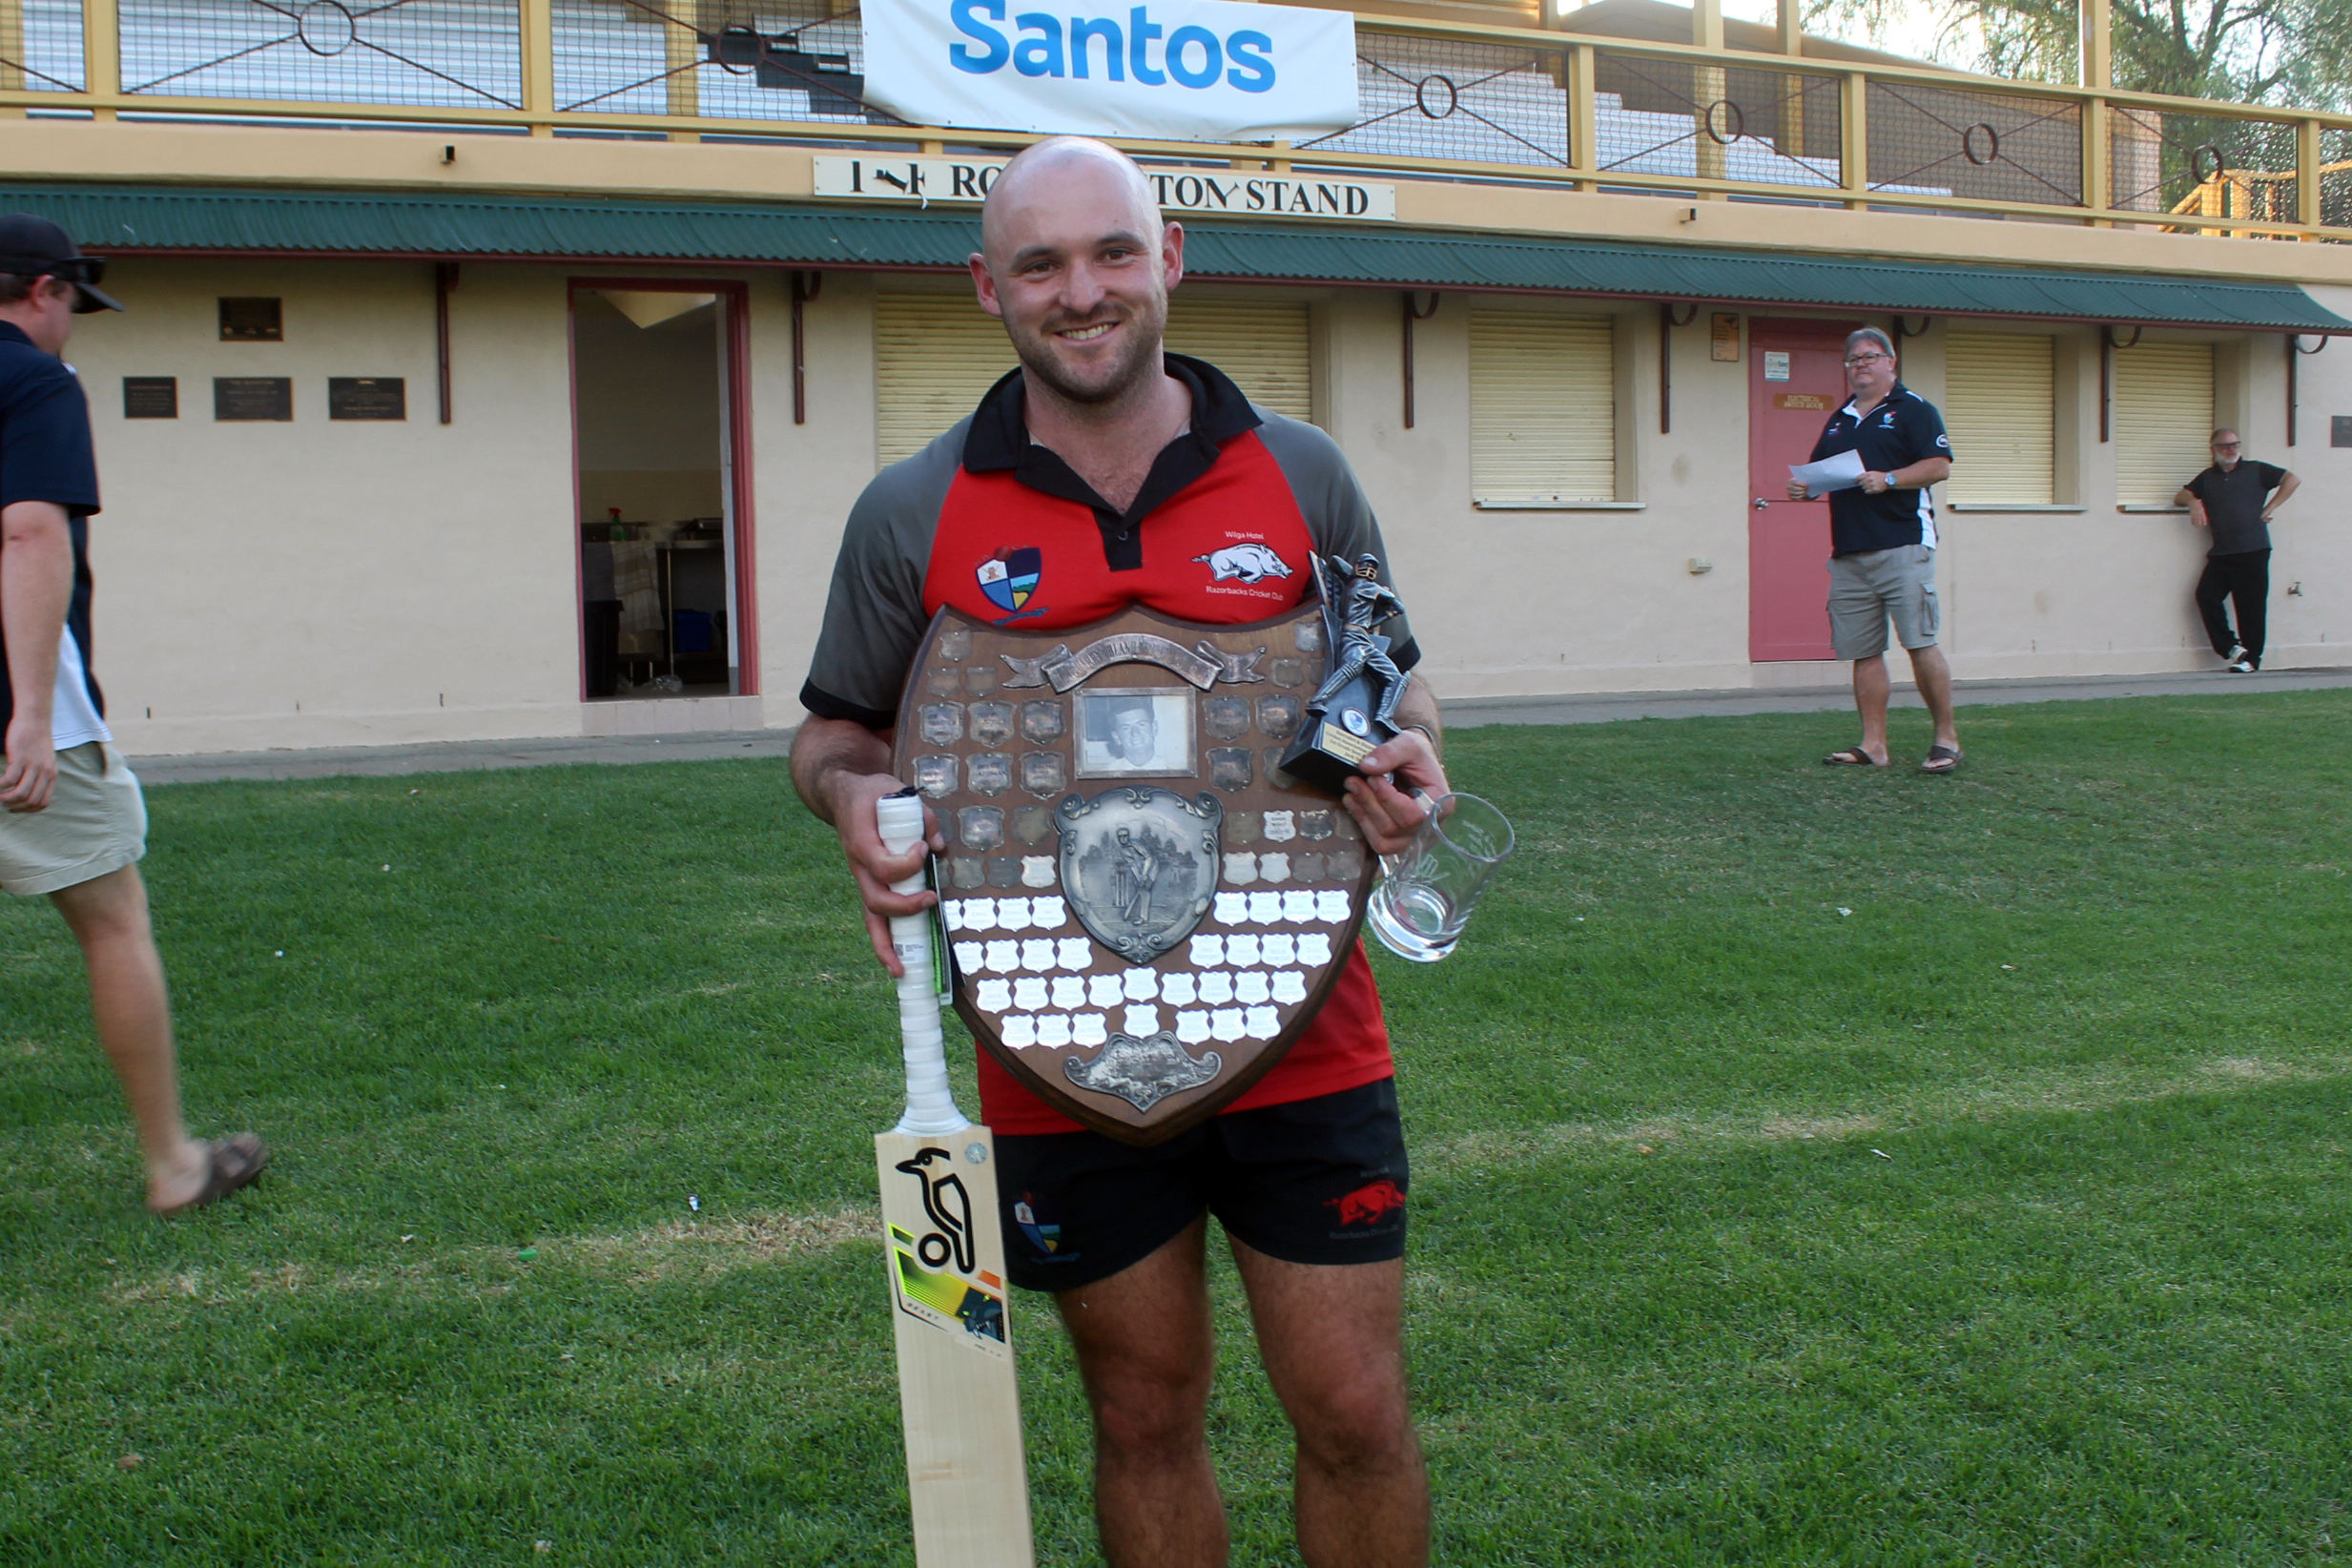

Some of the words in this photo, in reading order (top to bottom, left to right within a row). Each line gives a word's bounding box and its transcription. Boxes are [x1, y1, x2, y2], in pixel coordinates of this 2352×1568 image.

[949, 0, 1276, 93] Santos
[1147, 174, 1240, 208] TON
[1246, 179, 1369, 216] STAND
[1225, 530, 1245, 540] Wilga
[1206, 586, 1248, 596] Razorbacks
[1248, 588, 1270, 599] Cricket
[1271, 592, 1284, 601] Club
